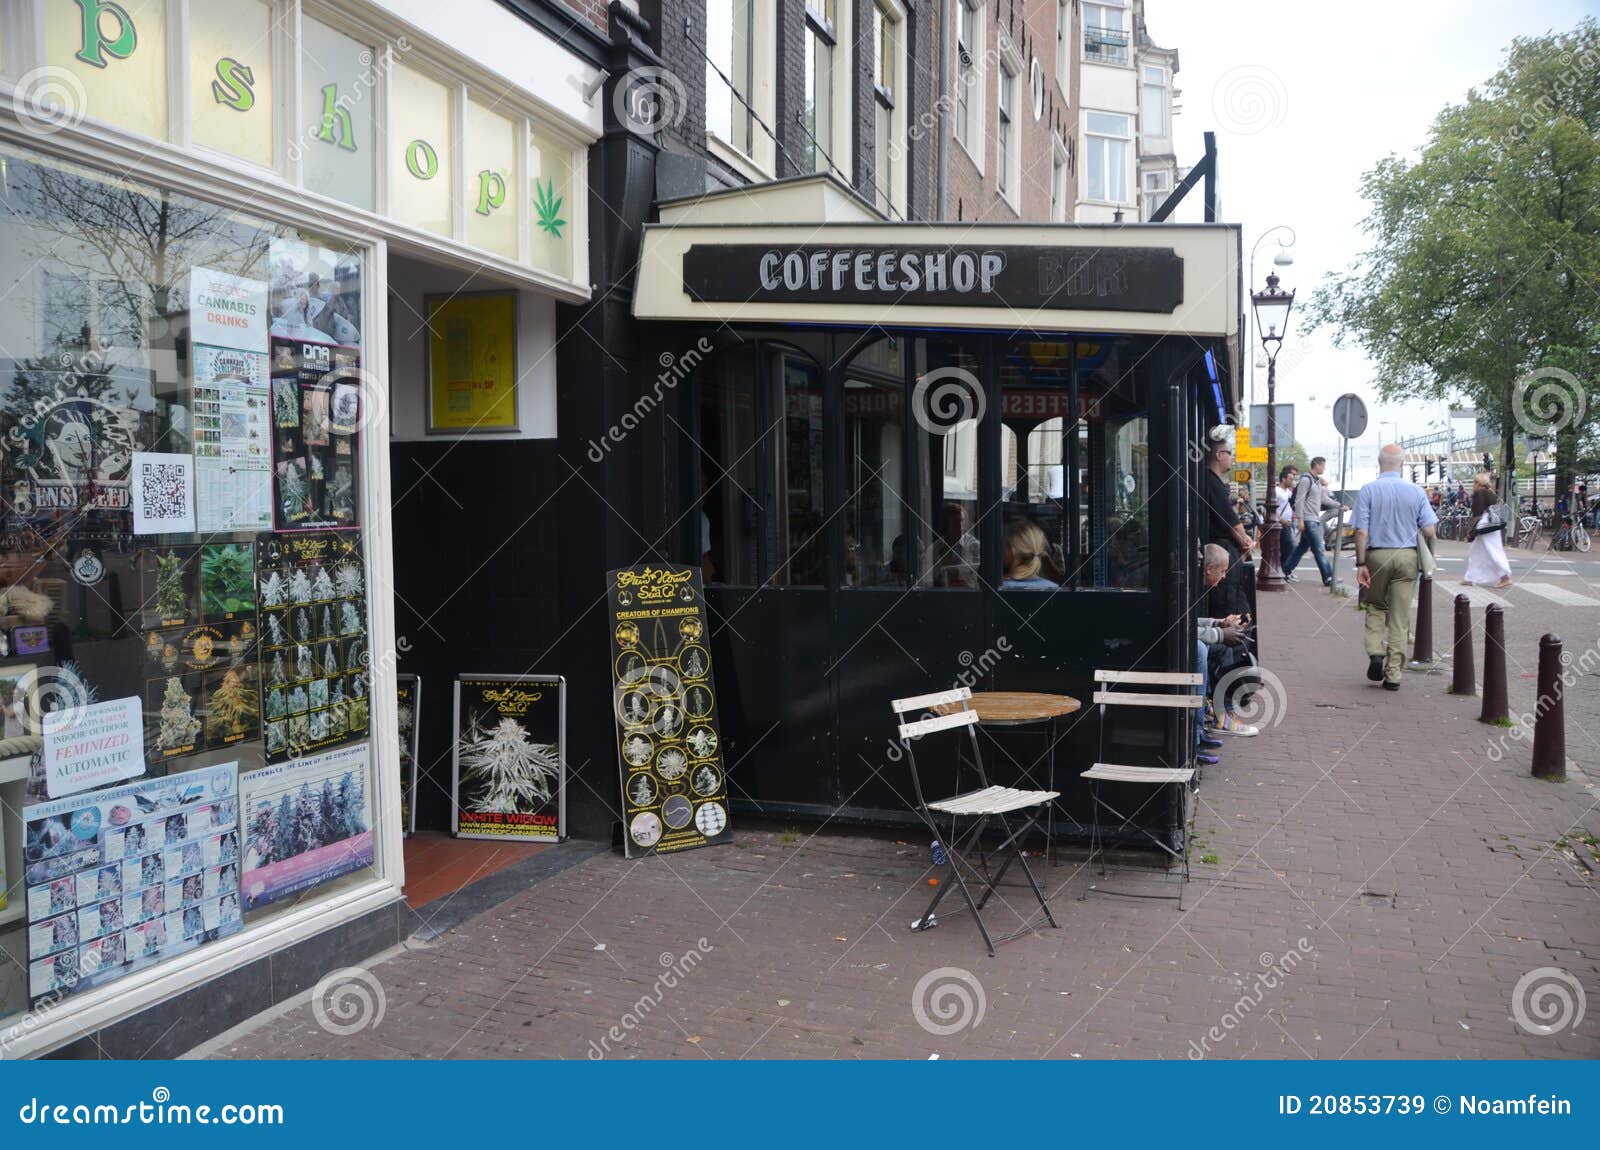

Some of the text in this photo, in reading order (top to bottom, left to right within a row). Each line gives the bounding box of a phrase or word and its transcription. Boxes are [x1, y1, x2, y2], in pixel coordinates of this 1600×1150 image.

[758, 249, 1008, 294] COFFEESHOP
[198, 294, 257, 316] CANNABIS
[208, 312, 249, 328] DRINKS
[616, 610, 650, 620] CREATORS
[661, 606, 699, 616] CHAMPIONS
[55, 732, 130, 761] FEMINIZED
[56, 749, 130, 778] AUTOMATIC
[459, 812, 557, 825] WHITE WIDOW
